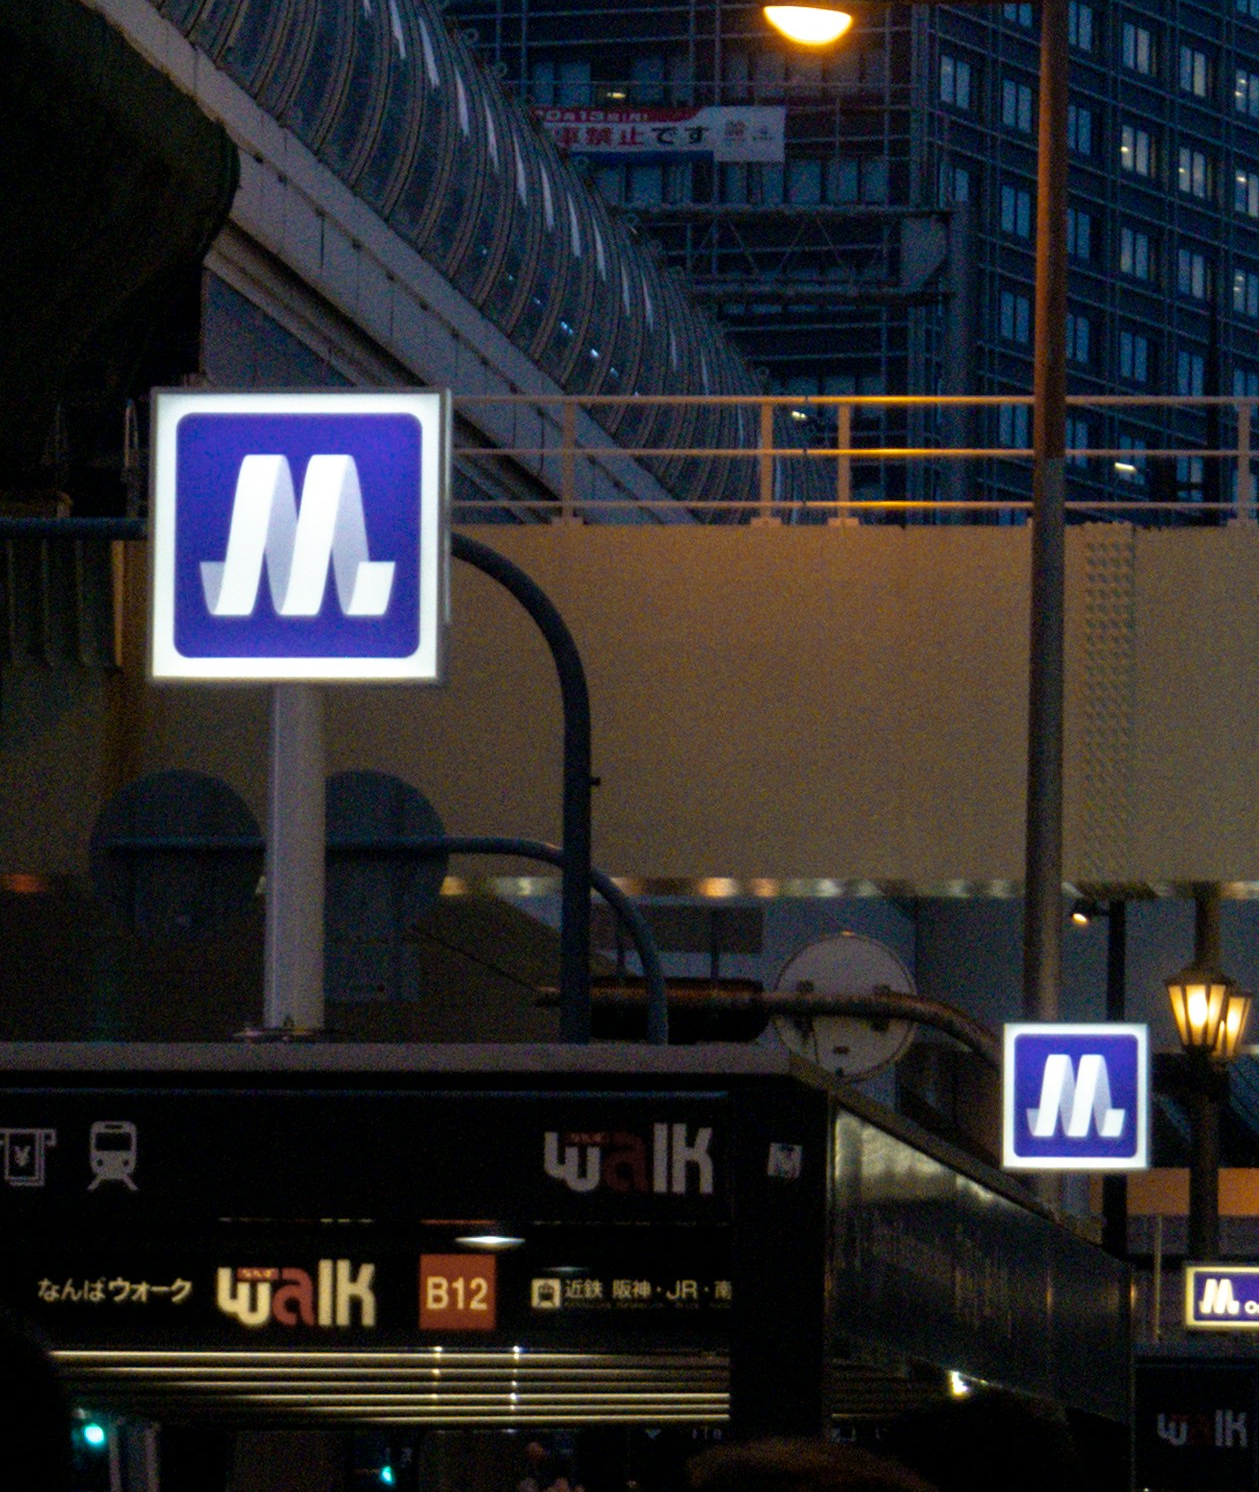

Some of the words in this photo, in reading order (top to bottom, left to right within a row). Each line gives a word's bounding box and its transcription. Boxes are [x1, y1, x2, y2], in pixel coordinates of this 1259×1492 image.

[38, 1277, 192, 1303] なんばウォーク
[426, 1276, 488, 1310] B12
